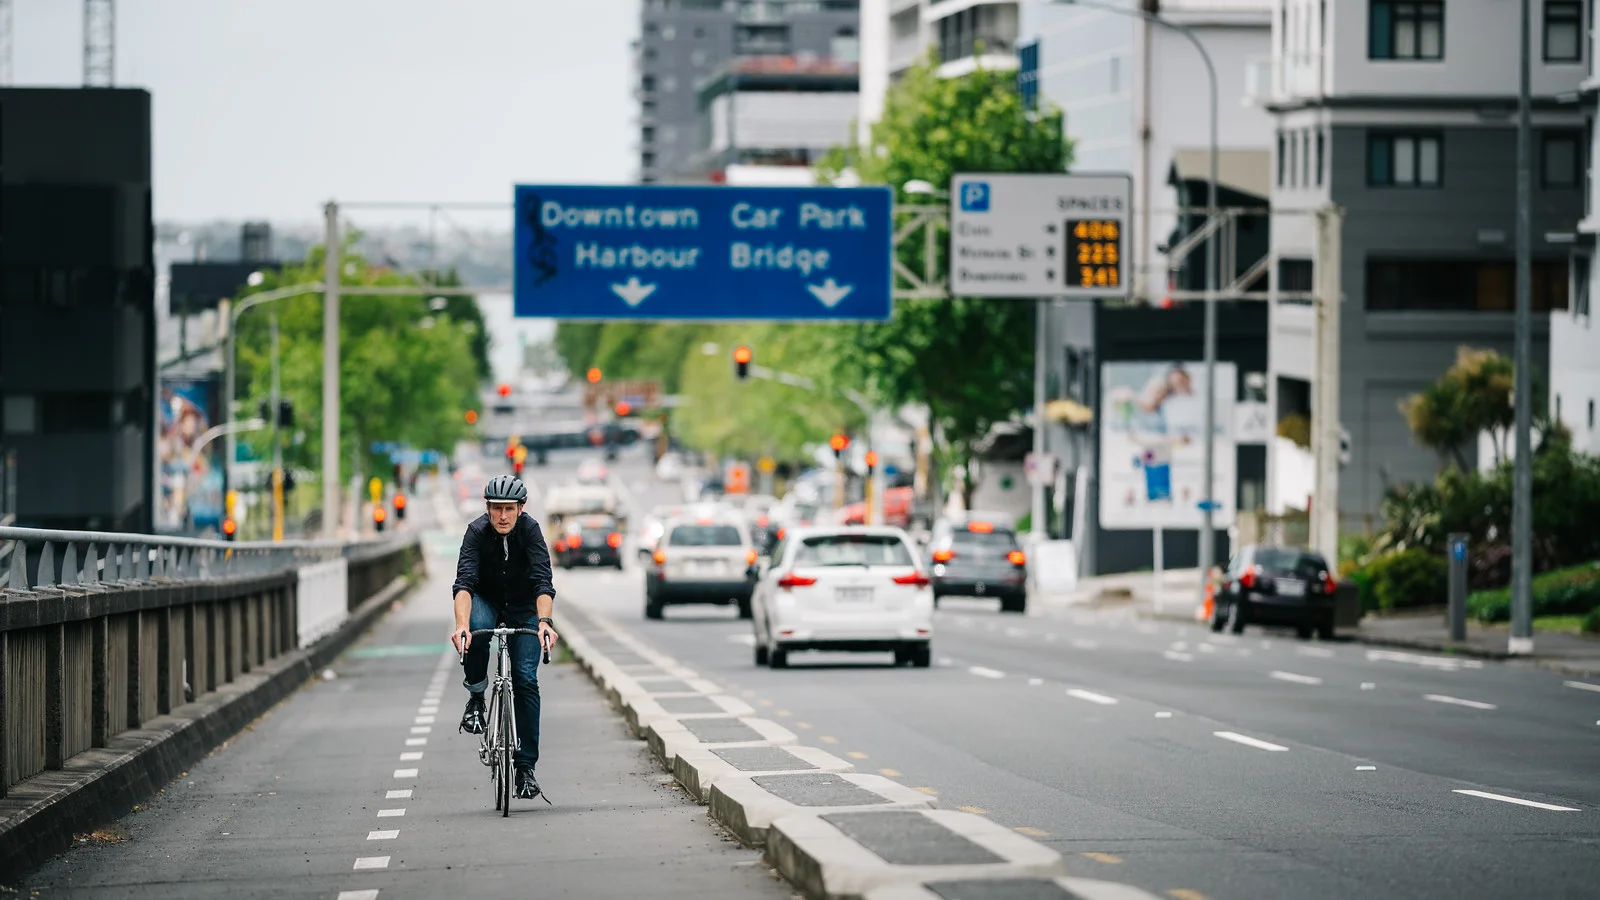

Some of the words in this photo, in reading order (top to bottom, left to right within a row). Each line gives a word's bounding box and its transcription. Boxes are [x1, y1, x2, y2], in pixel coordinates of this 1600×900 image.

[541, 201, 698, 228] Downtown
[731, 203, 782, 228] Car
[800, 203, 865, 228] Park
[576, 243, 700, 268] Harbour
[730, 243, 830, 275] Bridge
